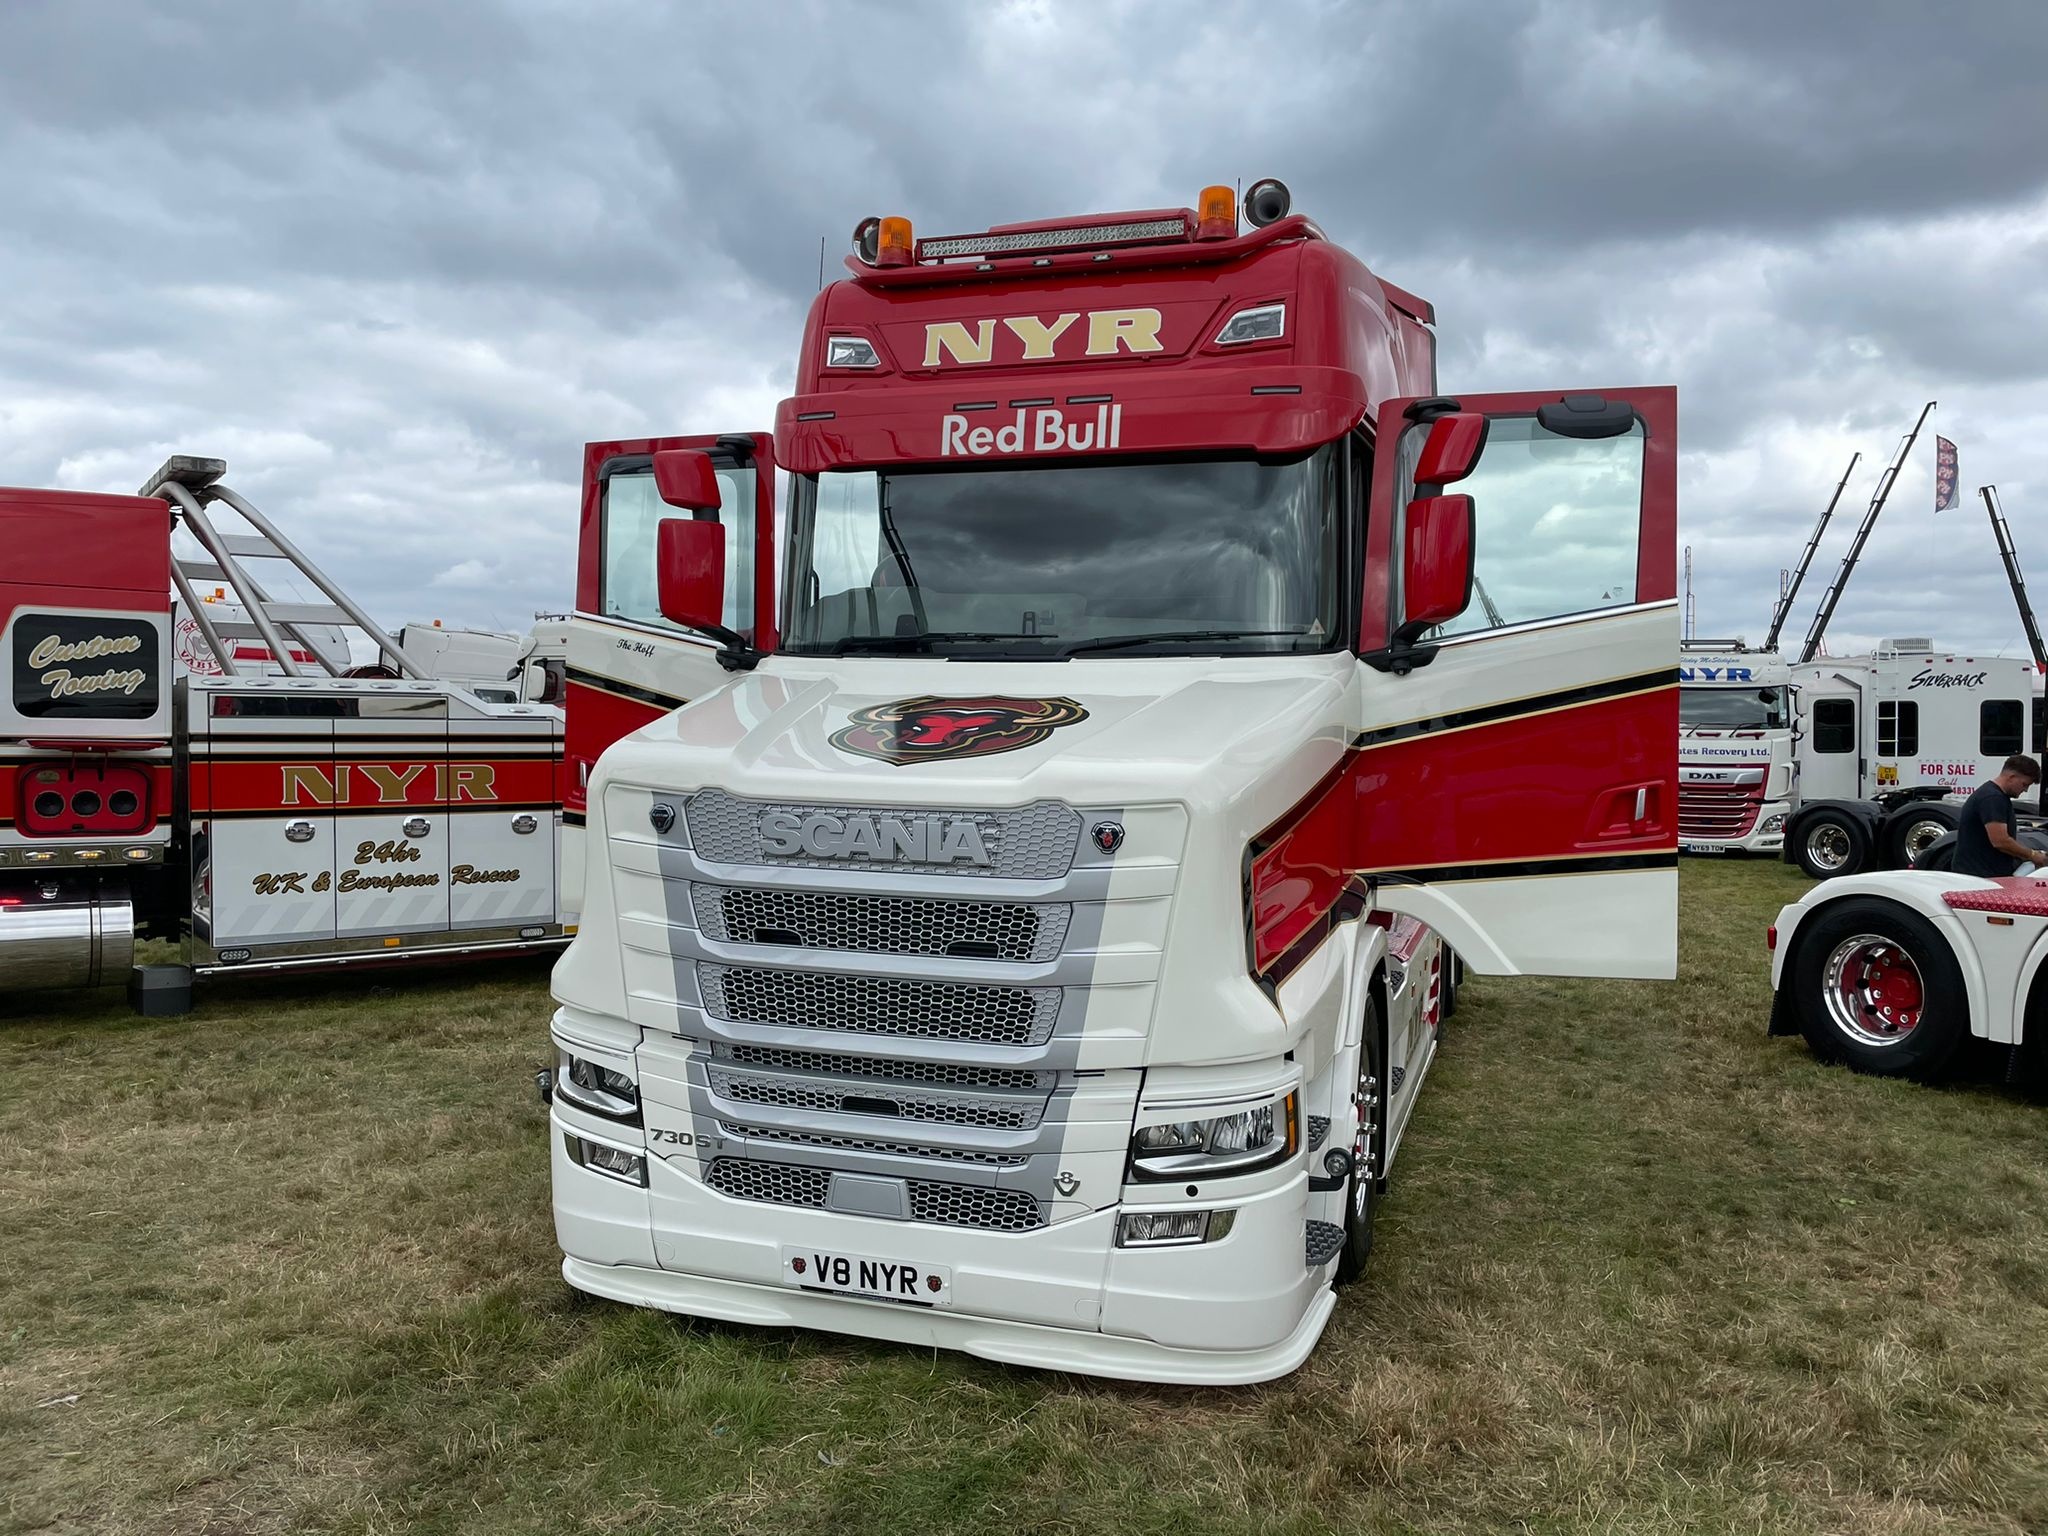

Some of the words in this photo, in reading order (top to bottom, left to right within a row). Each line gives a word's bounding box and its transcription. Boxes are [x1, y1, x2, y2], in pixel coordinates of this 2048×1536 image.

[922, 308, 1164, 366] NYR
[941, 408, 1027, 456] Red
[1034, 403, 1122, 451] Bull
[28, 634, 142, 669] Custom
[616, 638, 632, 651] The
[632, 641, 656, 658] Hoff
[41, 668, 146, 699] Towing
[1907, 668, 1988, 690] SILVERBACK
[1701, 747, 1748, 757] Recovery
[1750, 748, 1770, 756] Ltd.
[281, 764, 499, 804] NYR
[1688, 772, 1728, 780] DAF
[1920, 764, 1943, 775] FOR
[1947, 764, 1975, 776] SALE
[1937, 777, 1958, 786] Call
[354, 840, 421, 864] 24hr
[759, 812, 992, 867] SCANIA
[252, 872, 308, 895] UK
[311, 870, 331, 893] &
[337, 869, 440, 893] European
[451, 864, 521, 885] Rescue
[814, 1254, 851, 1286] V8
[860, 1260, 918, 1296] NYR
